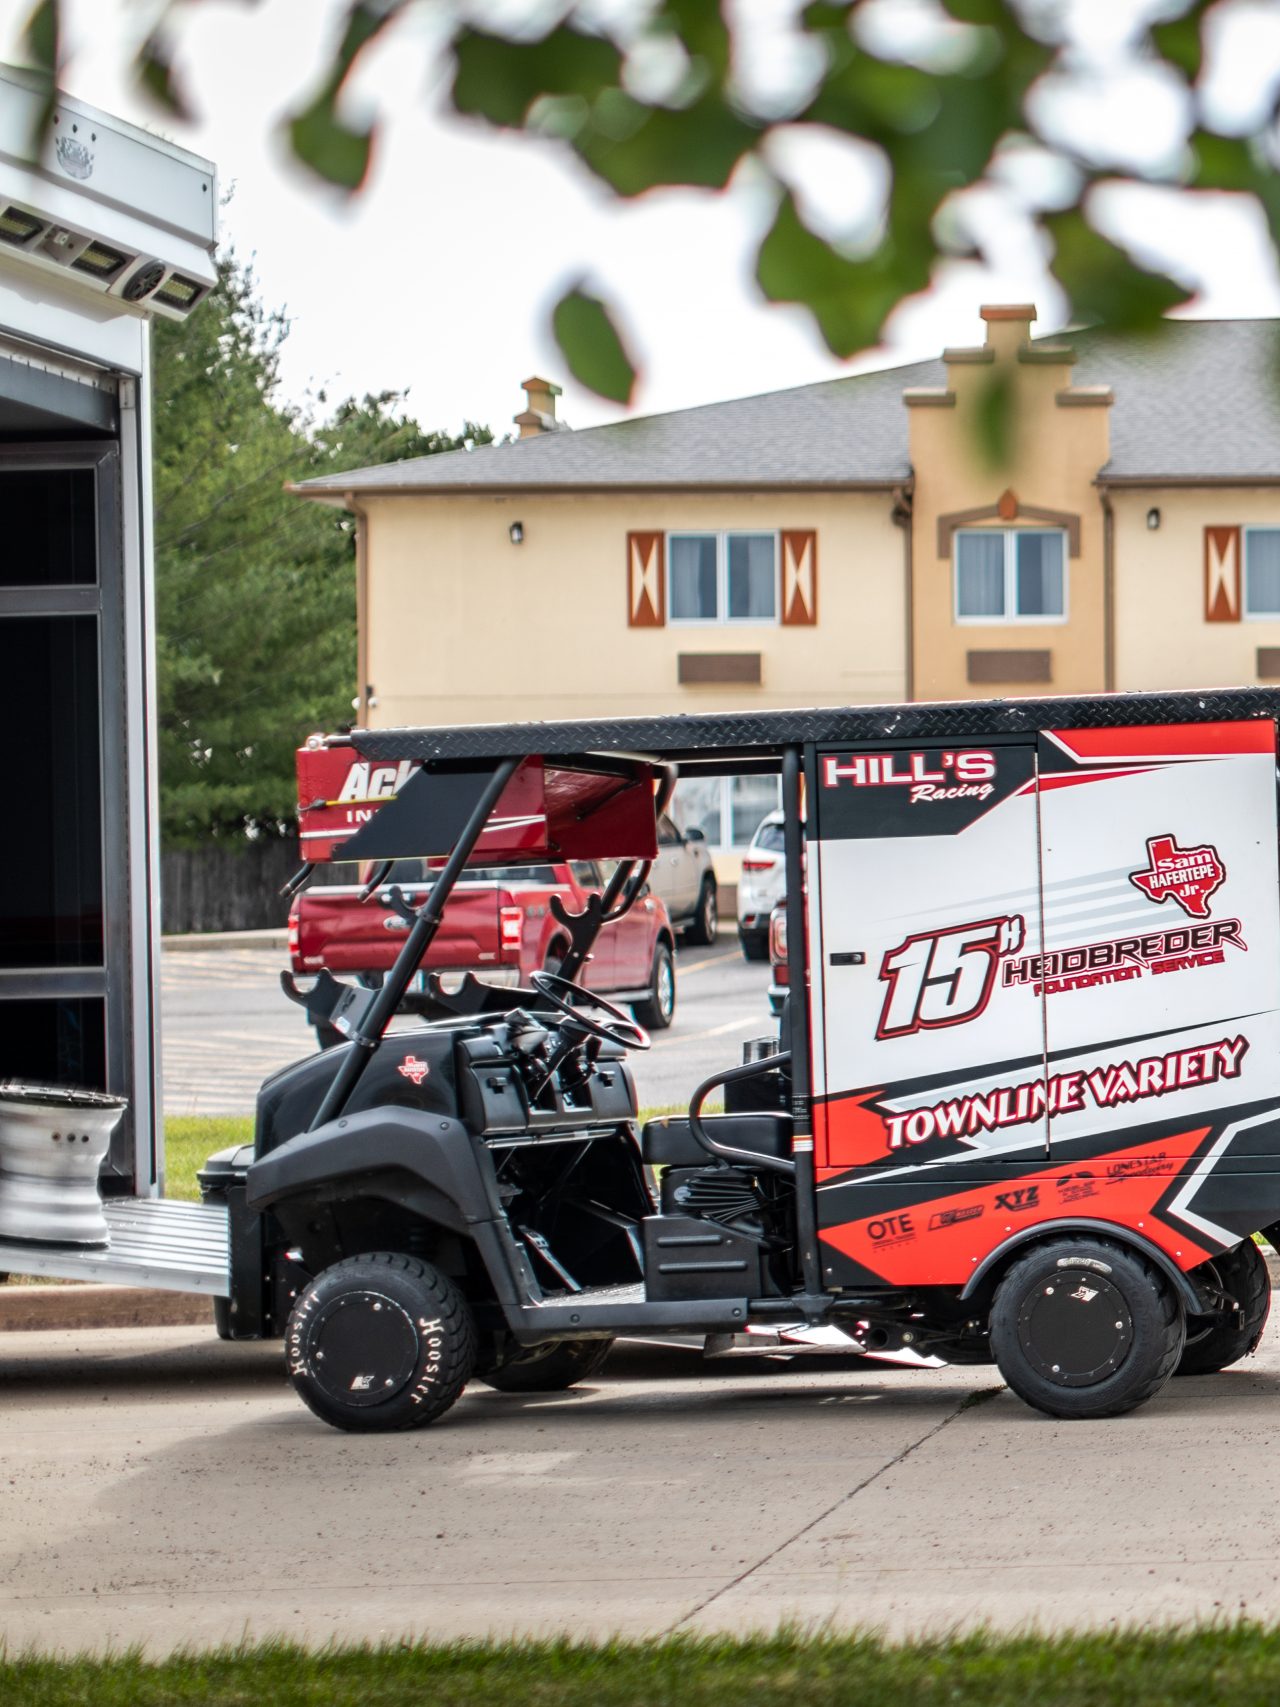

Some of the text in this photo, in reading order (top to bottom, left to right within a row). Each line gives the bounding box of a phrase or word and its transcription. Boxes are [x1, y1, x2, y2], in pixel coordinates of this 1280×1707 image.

[823, 751, 997, 788] HILL'S
[911, 783, 995, 804] Racing
[1148, 863, 1216, 889] HAFERTEPE
[1156, 852, 1212, 873] Sam
[1180, 884, 1205, 897] Jr.
[1003, 918, 1247, 986] HEIDBREDER
[1033, 949, 1226, 997] FOUNDATION SERVICE
[886, 1071, 1086, 1148] TOWNLINE
[1088, 1036, 1248, 1107] VARIETY
[867, 1213, 915, 1240] OTE
